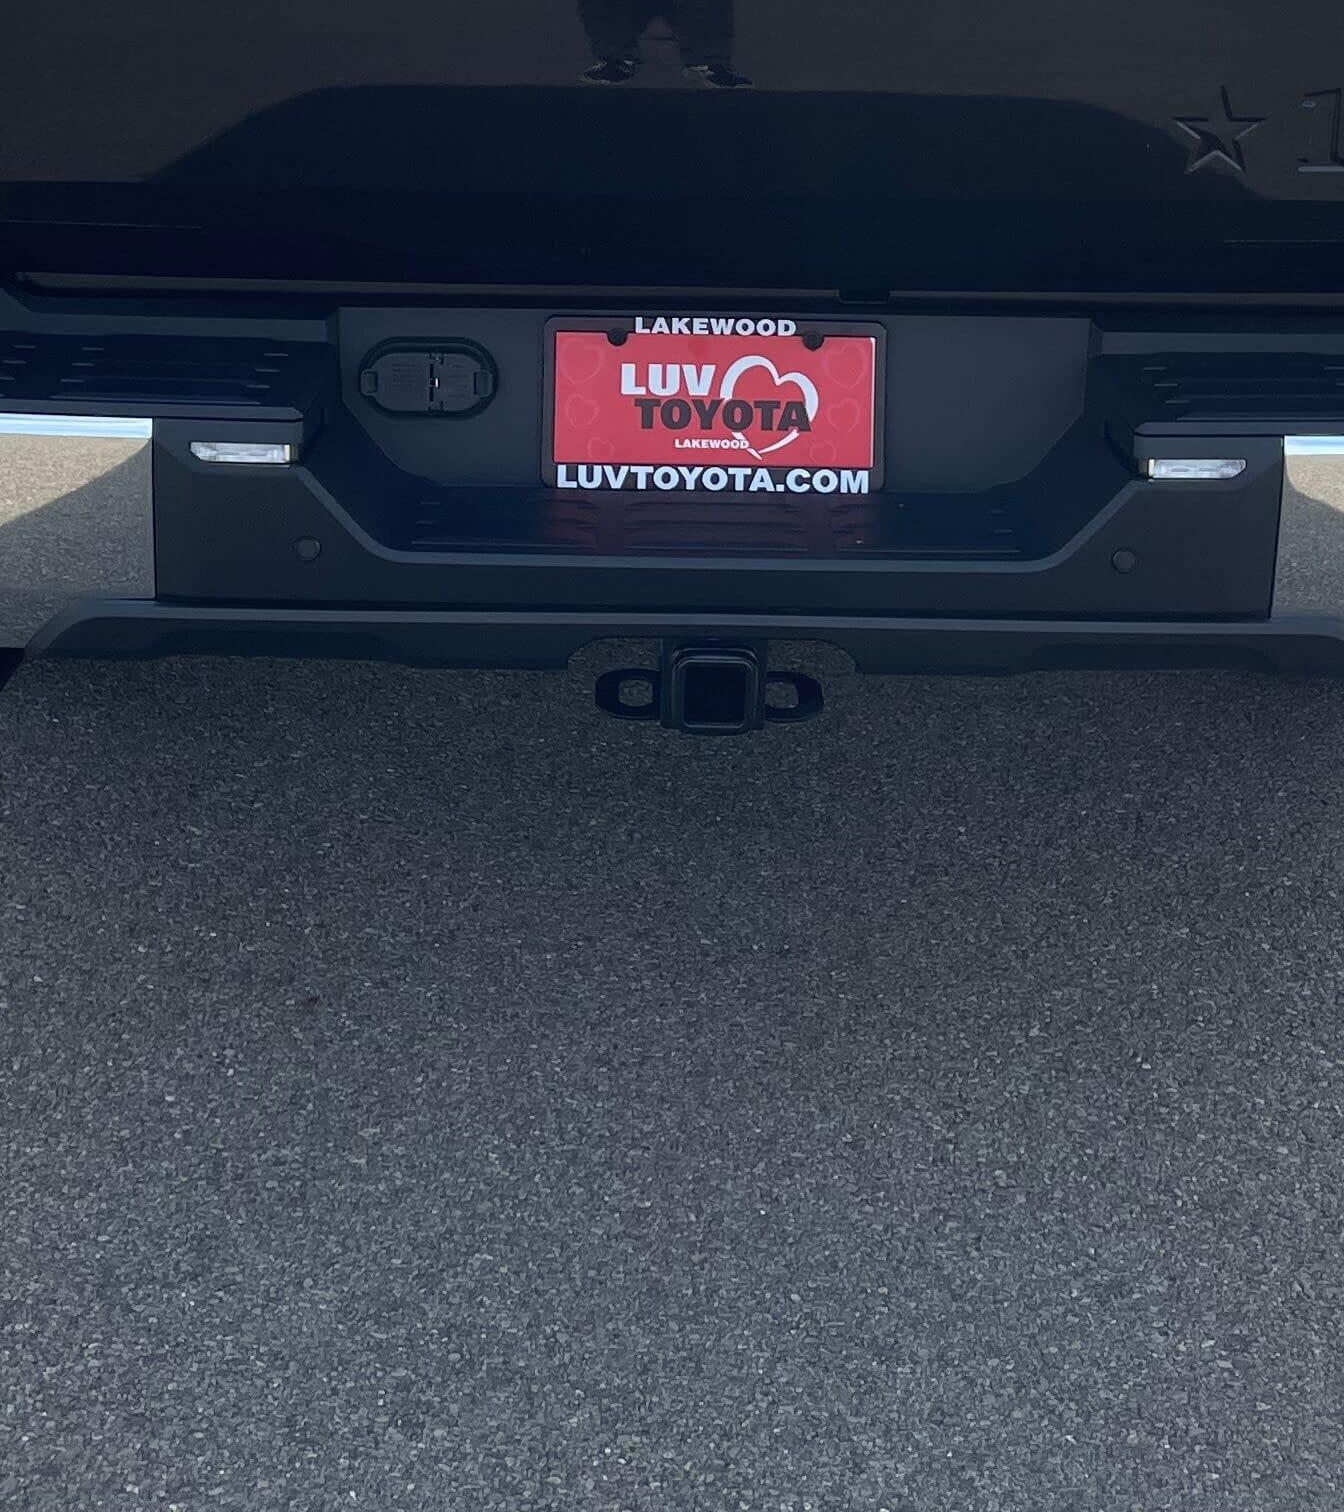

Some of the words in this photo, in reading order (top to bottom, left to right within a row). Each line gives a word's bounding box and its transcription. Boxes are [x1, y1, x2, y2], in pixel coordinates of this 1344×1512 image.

[634, 316, 797, 337] LAKEWOOD
[620, 362, 717, 396] LUV
[634, 398, 812, 432] TOYOTA
[674, 438, 750, 450] LAKEWOOD
[557, 464, 870, 494] LUVTOYOTA.COM
